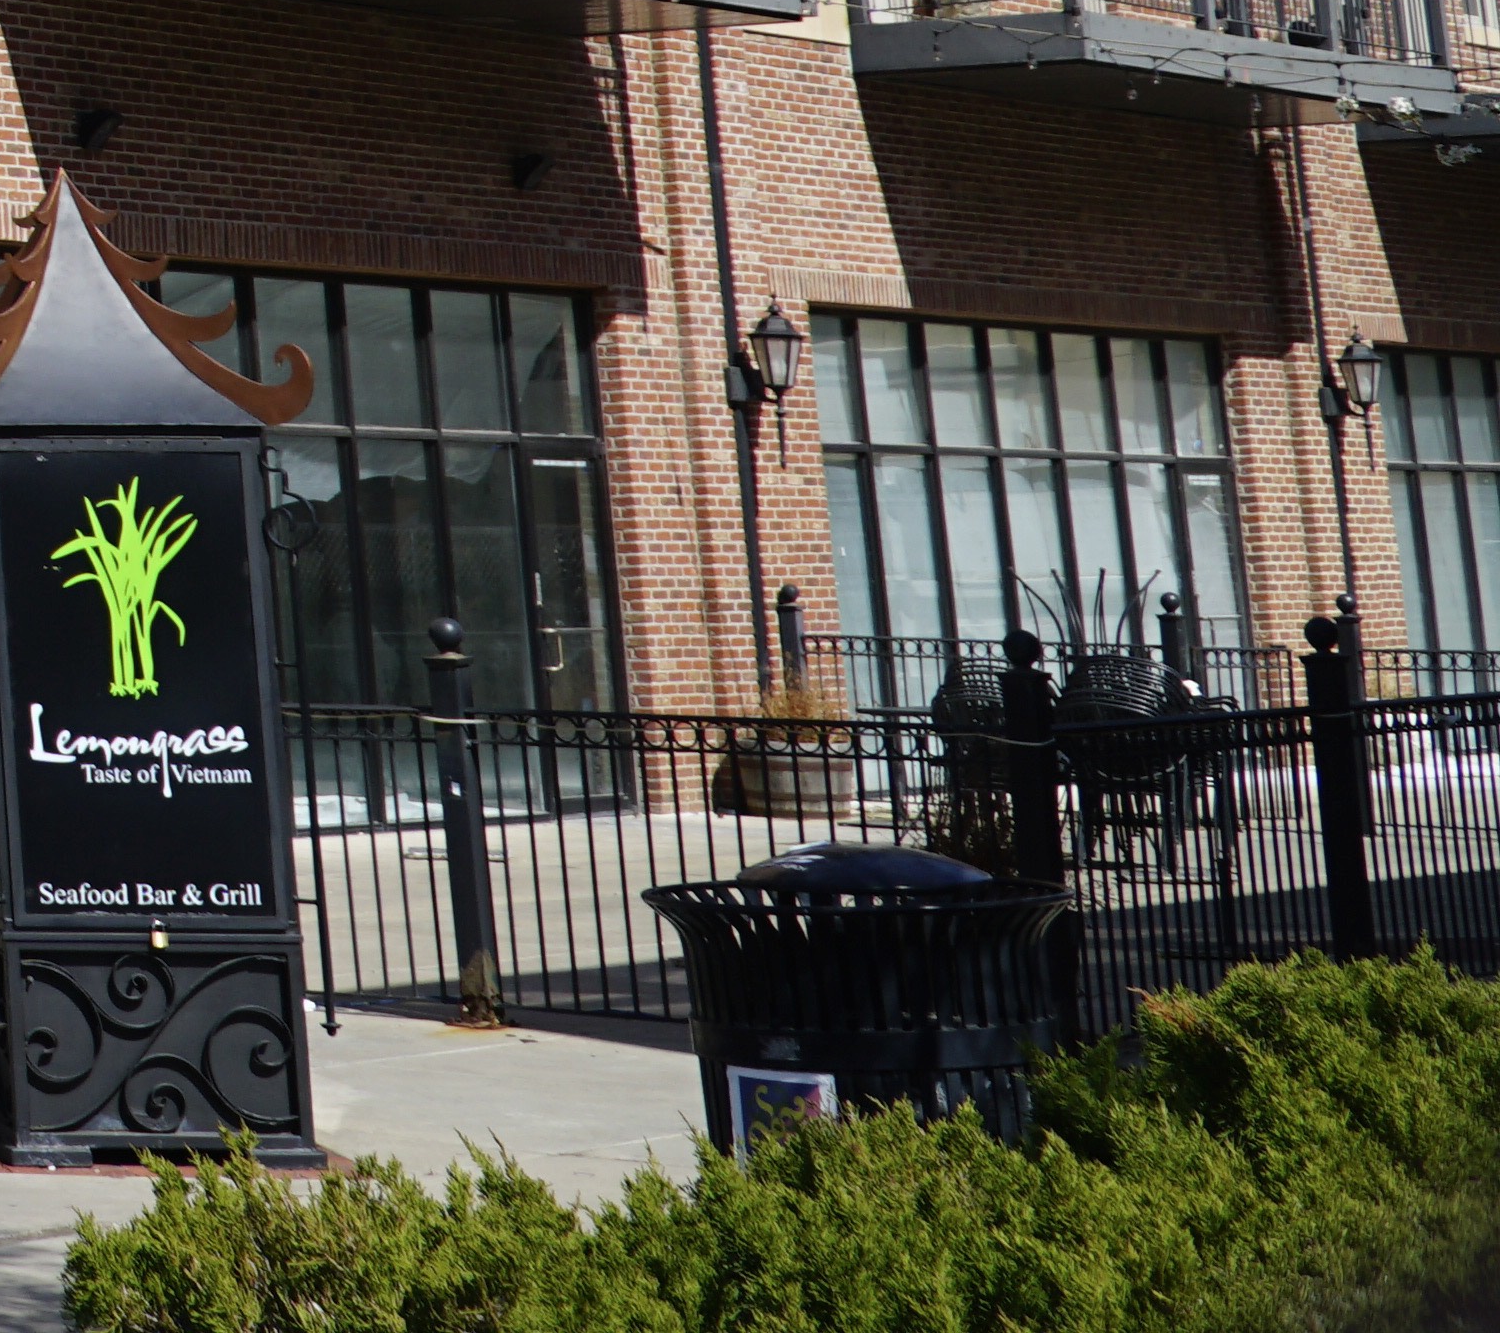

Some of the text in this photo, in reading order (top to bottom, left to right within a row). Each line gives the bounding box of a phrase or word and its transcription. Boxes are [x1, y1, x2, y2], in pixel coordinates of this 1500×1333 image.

[30, 703, 249, 798] Lemongrass
[81, 762, 253, 784] Taste of Vietnam
[38, 882, 263, 906] Seafood Bar & Grill
